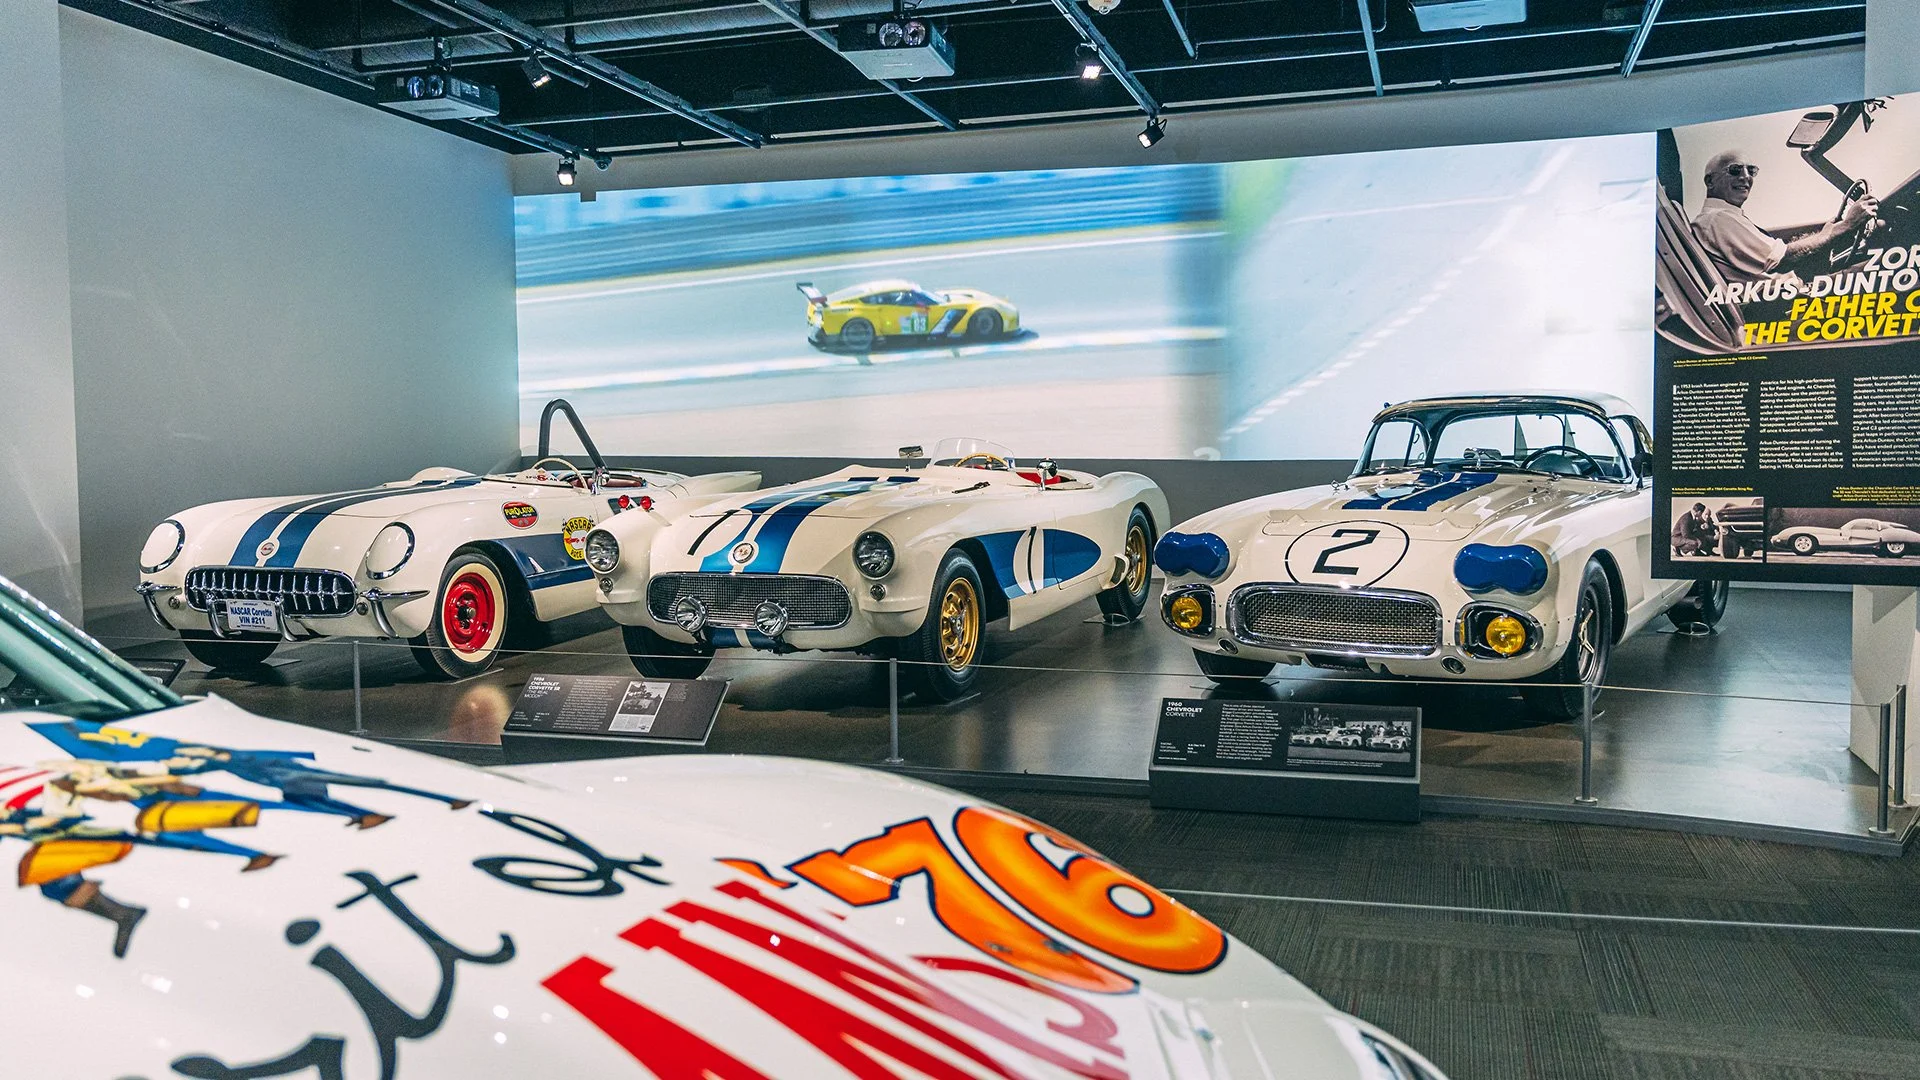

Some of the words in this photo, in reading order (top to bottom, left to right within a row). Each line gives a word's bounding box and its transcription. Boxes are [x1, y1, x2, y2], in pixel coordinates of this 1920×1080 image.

[1703, 268, 1920, 306] ARKUS-DUNTO
[1790, 292, 1897, 320] FATHER
[1743, 321, 1792, 345] THE
[1797, 313, 1920, 342] CORVET
[504, 507, 535, 516] PUROLATOR
[566, 519, 591, 535] NASCAR
[1312, 528, 1381, 575] 2
[230, 607, 251, 615] NASCAR
[251, 608, 272, 616] Corvette
